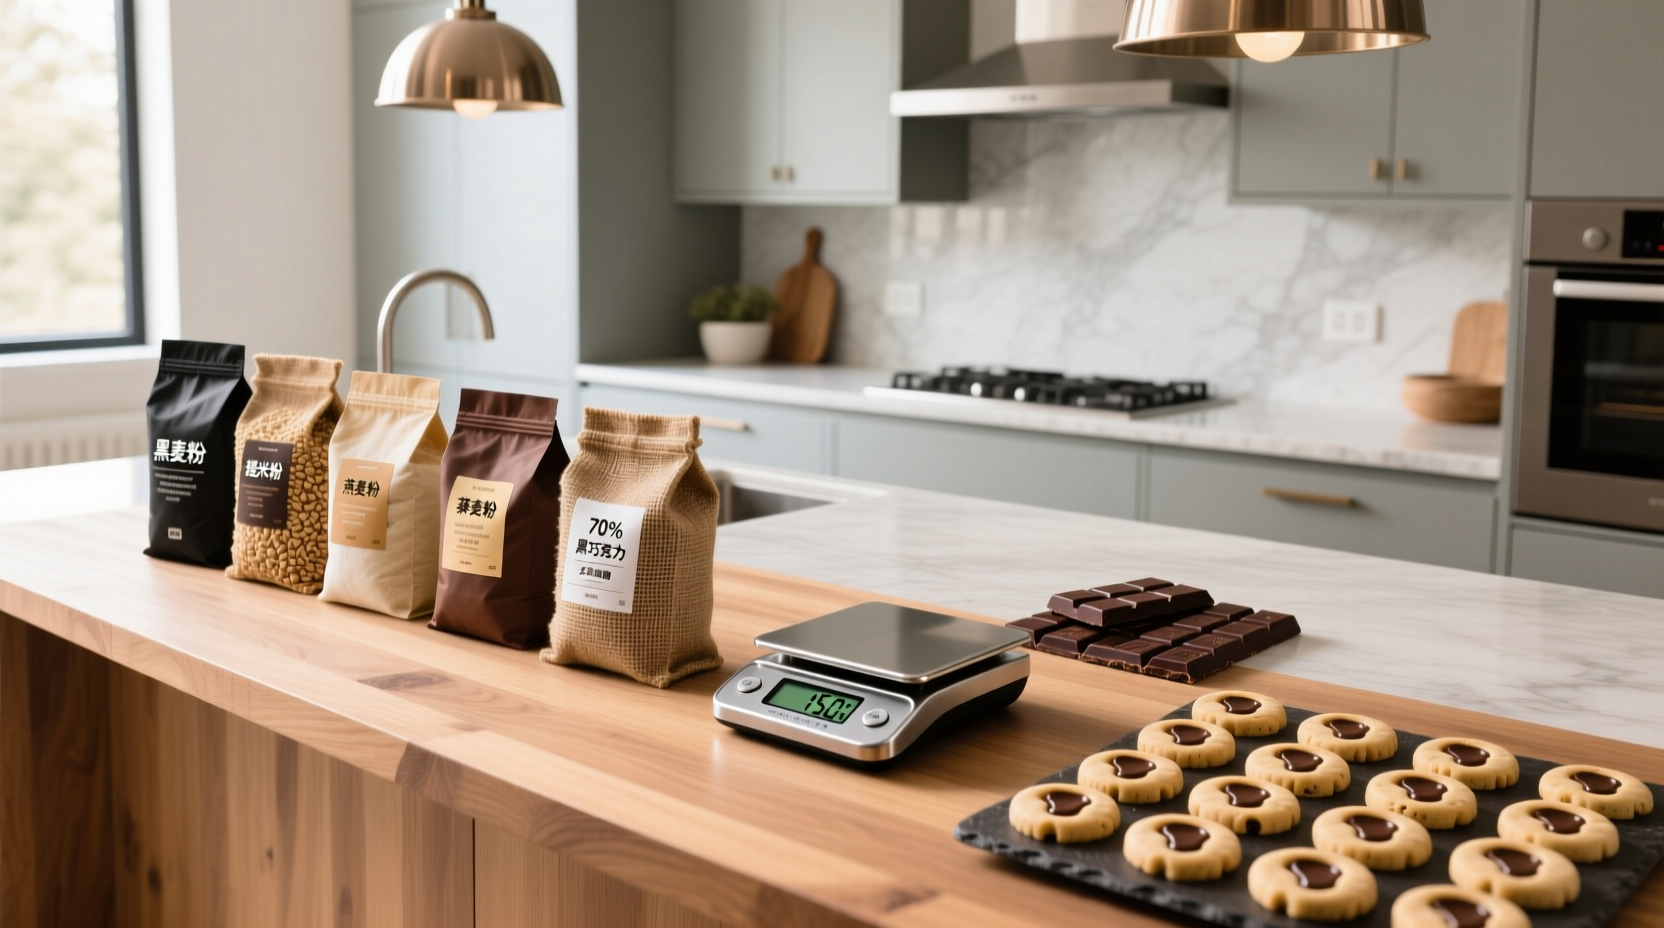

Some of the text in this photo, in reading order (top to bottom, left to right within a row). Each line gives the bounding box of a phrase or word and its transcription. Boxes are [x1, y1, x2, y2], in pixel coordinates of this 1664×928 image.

[153, 438, 207, 465] 黑麦粉
[588, 517, 623, 540] 70%
